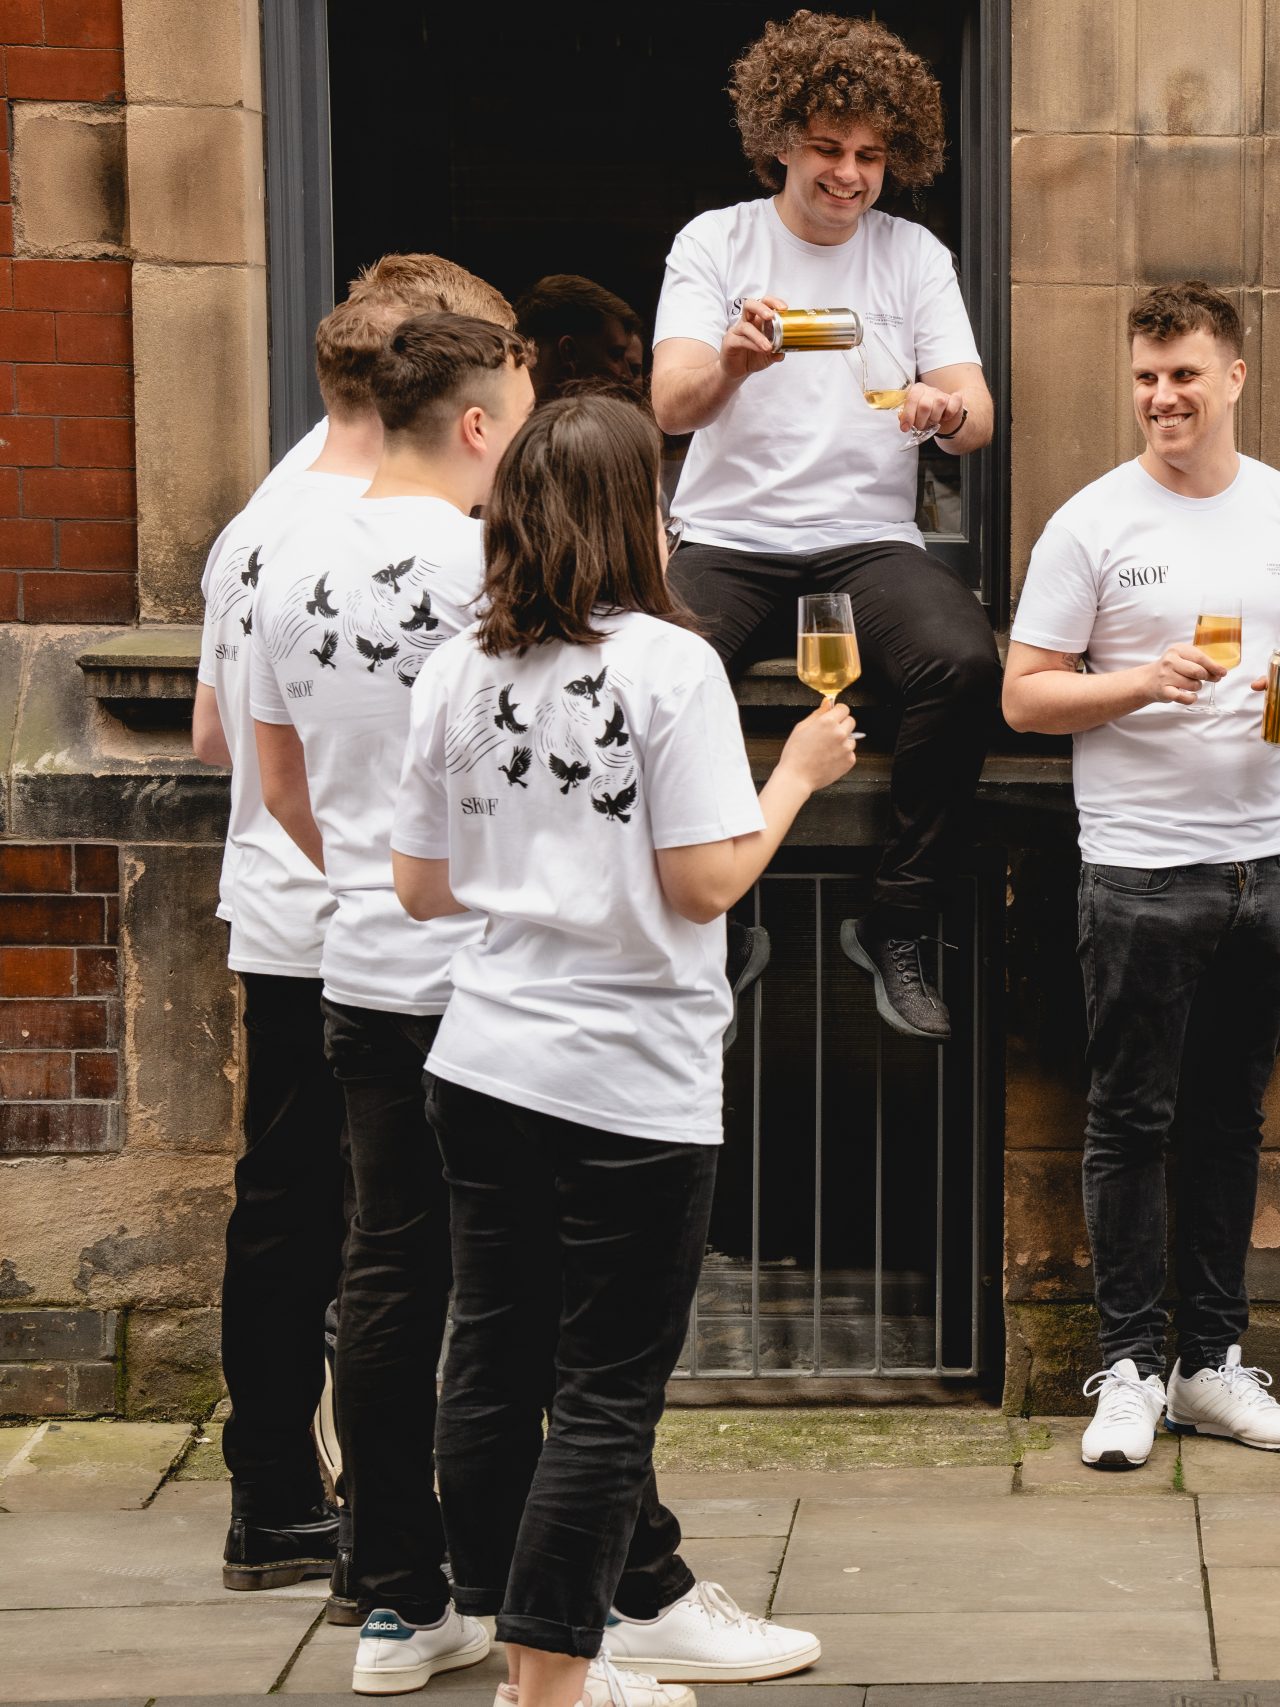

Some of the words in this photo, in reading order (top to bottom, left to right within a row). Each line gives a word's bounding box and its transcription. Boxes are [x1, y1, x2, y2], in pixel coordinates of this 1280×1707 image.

[1118, 566, 1169, 588] SKOF
[286, 680, 314, 698] SKOF
[461, 797, 499, 816] SKOF
[368, 1621, 398, 1630] adidas
